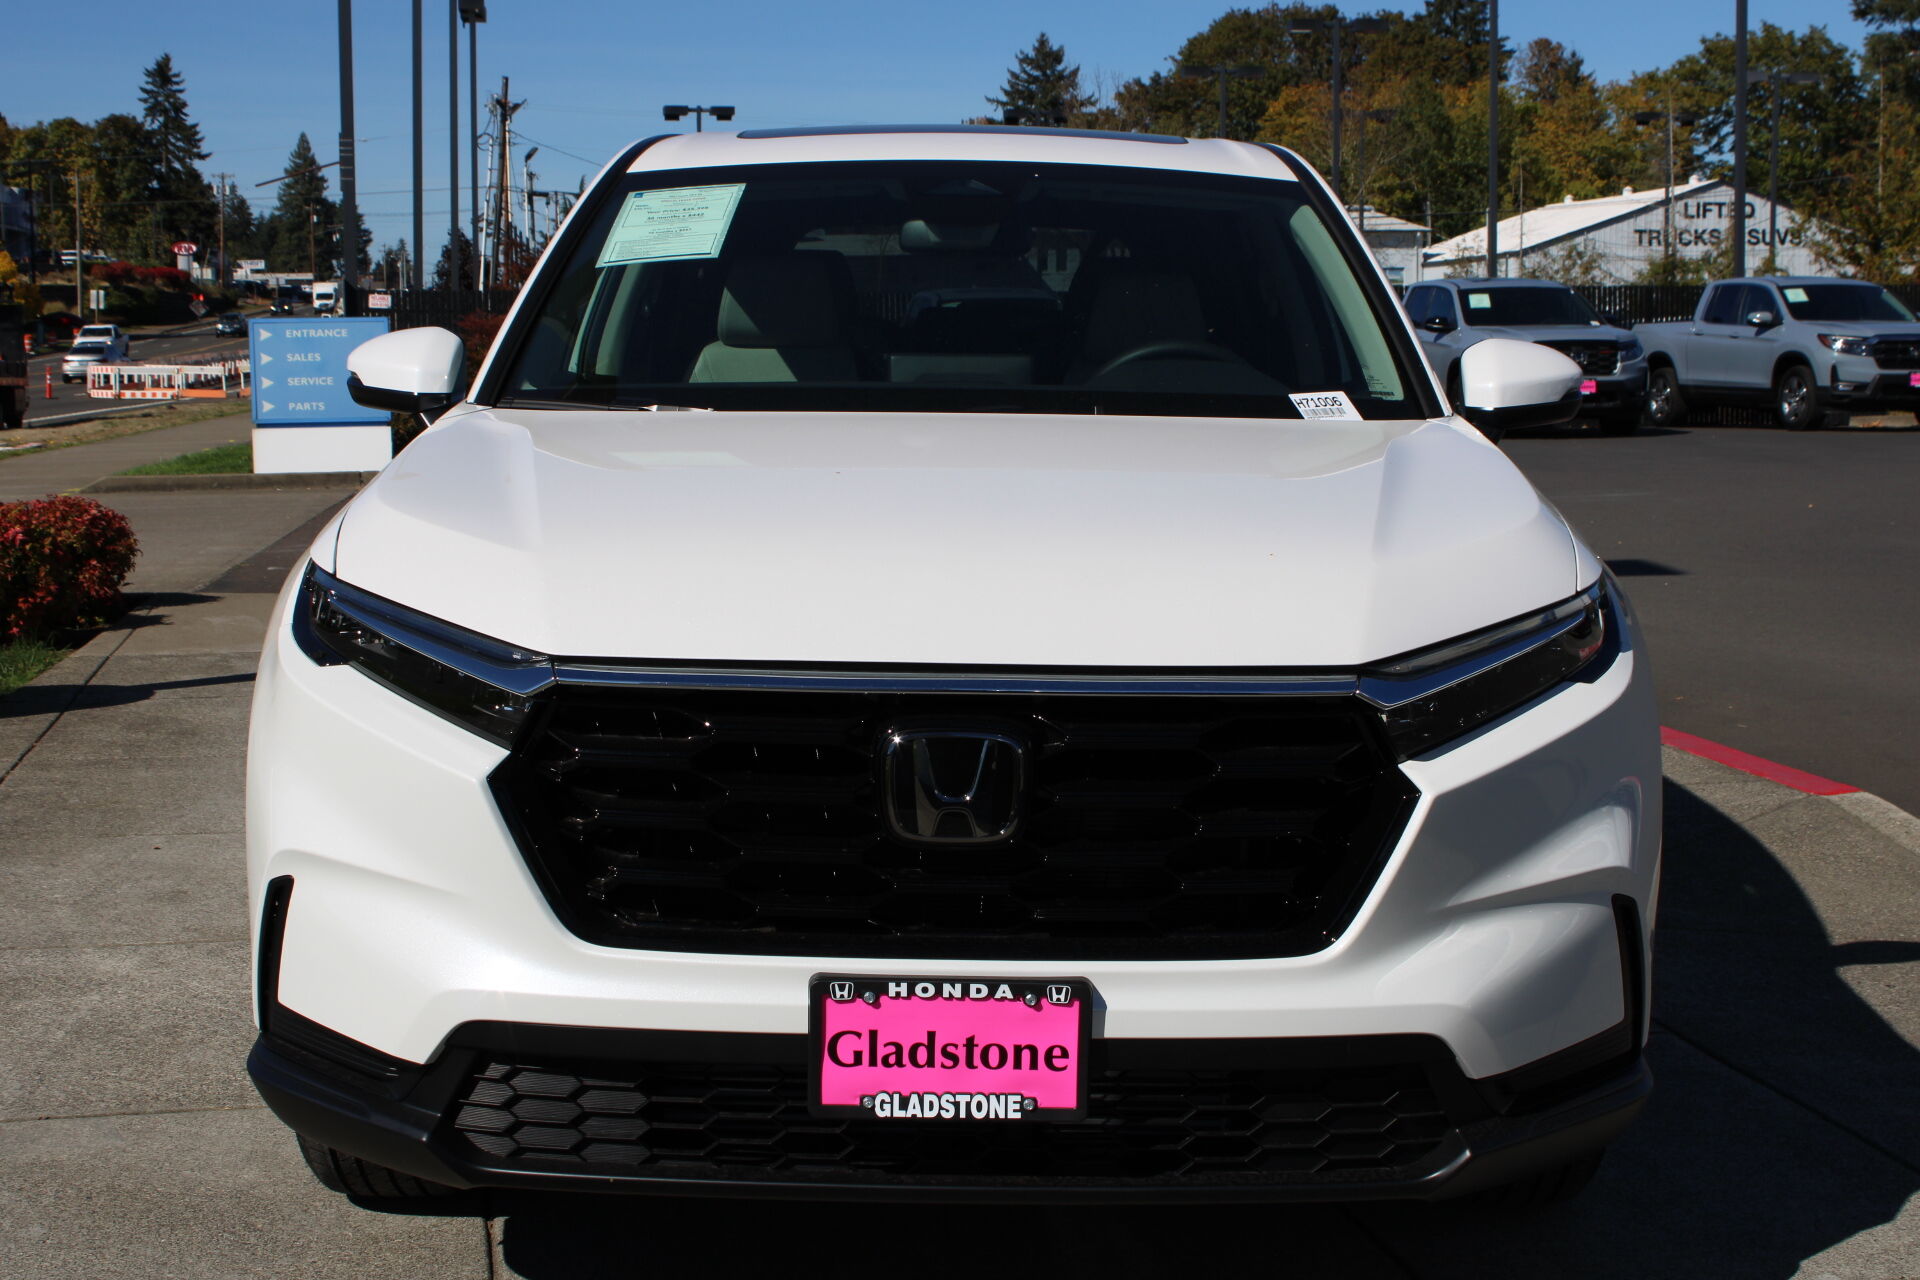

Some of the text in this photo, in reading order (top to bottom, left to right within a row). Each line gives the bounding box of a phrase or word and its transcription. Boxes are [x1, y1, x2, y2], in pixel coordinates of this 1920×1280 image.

[1633, 228, 1722, 246] TRCKS
[285, 328, 348, 338] ENTRANCE
[286, 353, 321, 362] SALES
[287, 377, 334, 386] SERVICE
[288, 402, 326, 411] PARTS
[1294, 396, 1343, 409] H71006
[888, 982, 1014, 999] HONDA
[827, 1029, 1070, 1072] Gladstone
[874, 1092, 1022, 1119] GLADSTONE
